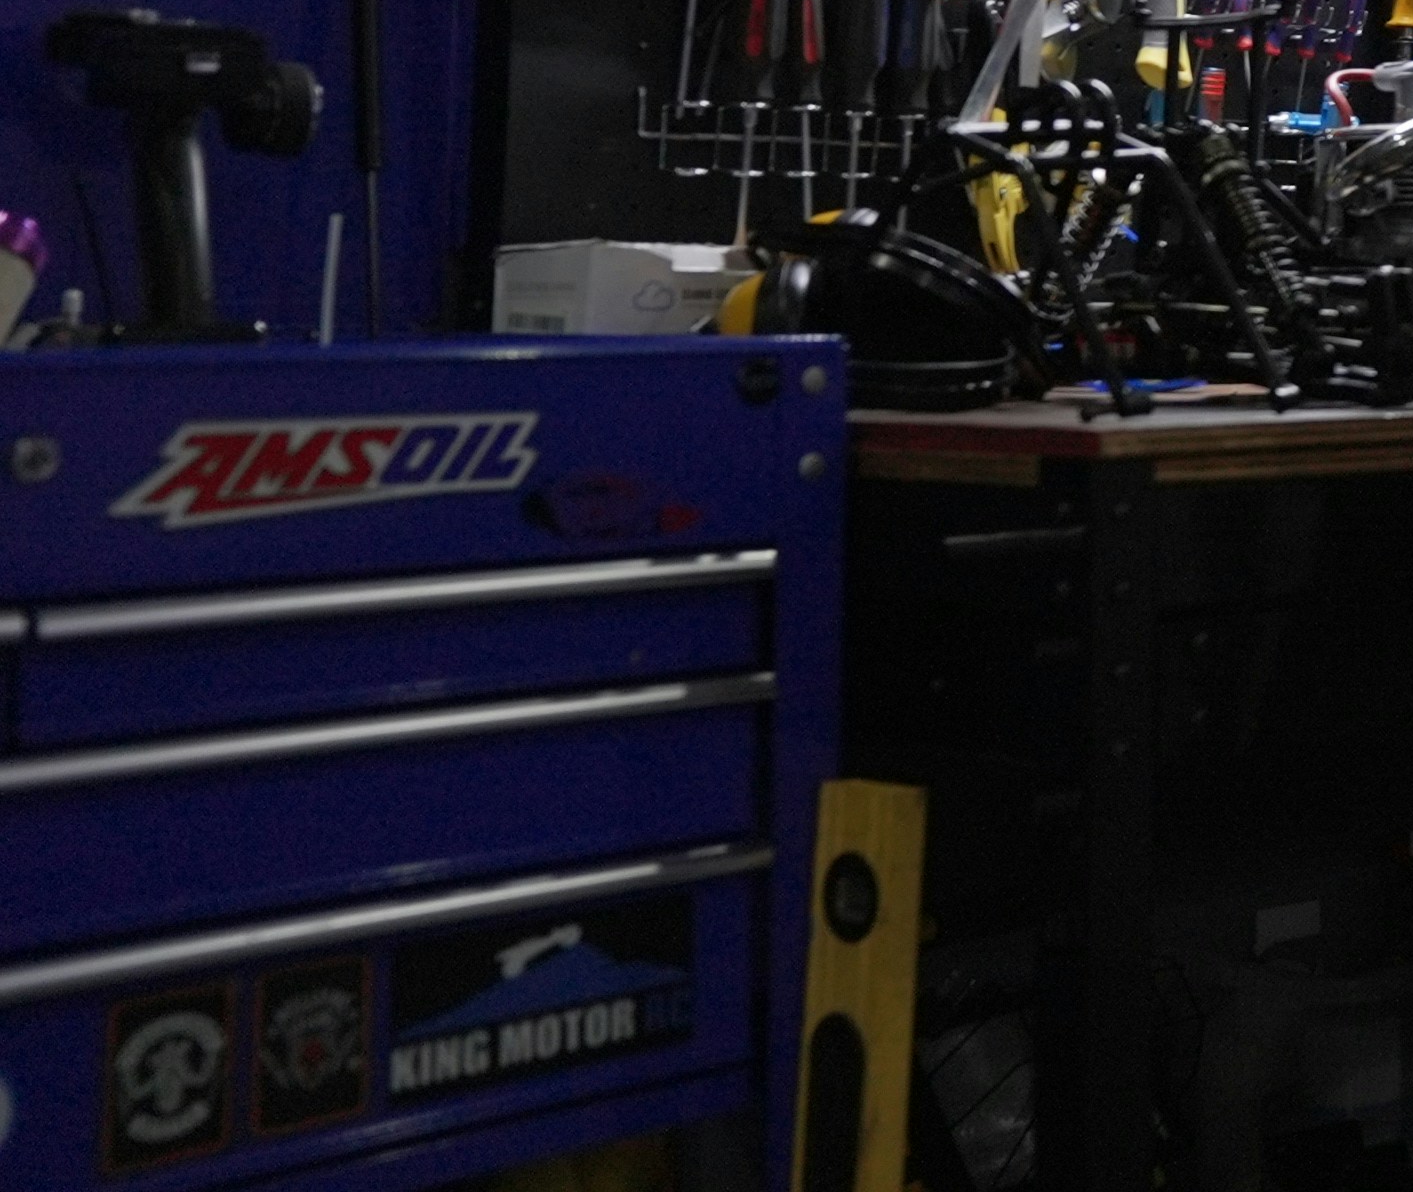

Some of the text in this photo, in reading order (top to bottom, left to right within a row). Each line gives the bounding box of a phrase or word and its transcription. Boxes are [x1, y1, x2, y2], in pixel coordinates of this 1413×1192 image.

[143, 421, 527, 515] AMSOIL
[390, 1028, 492, 1095] KING
[499, 997, 637, 1069] MOTOR
